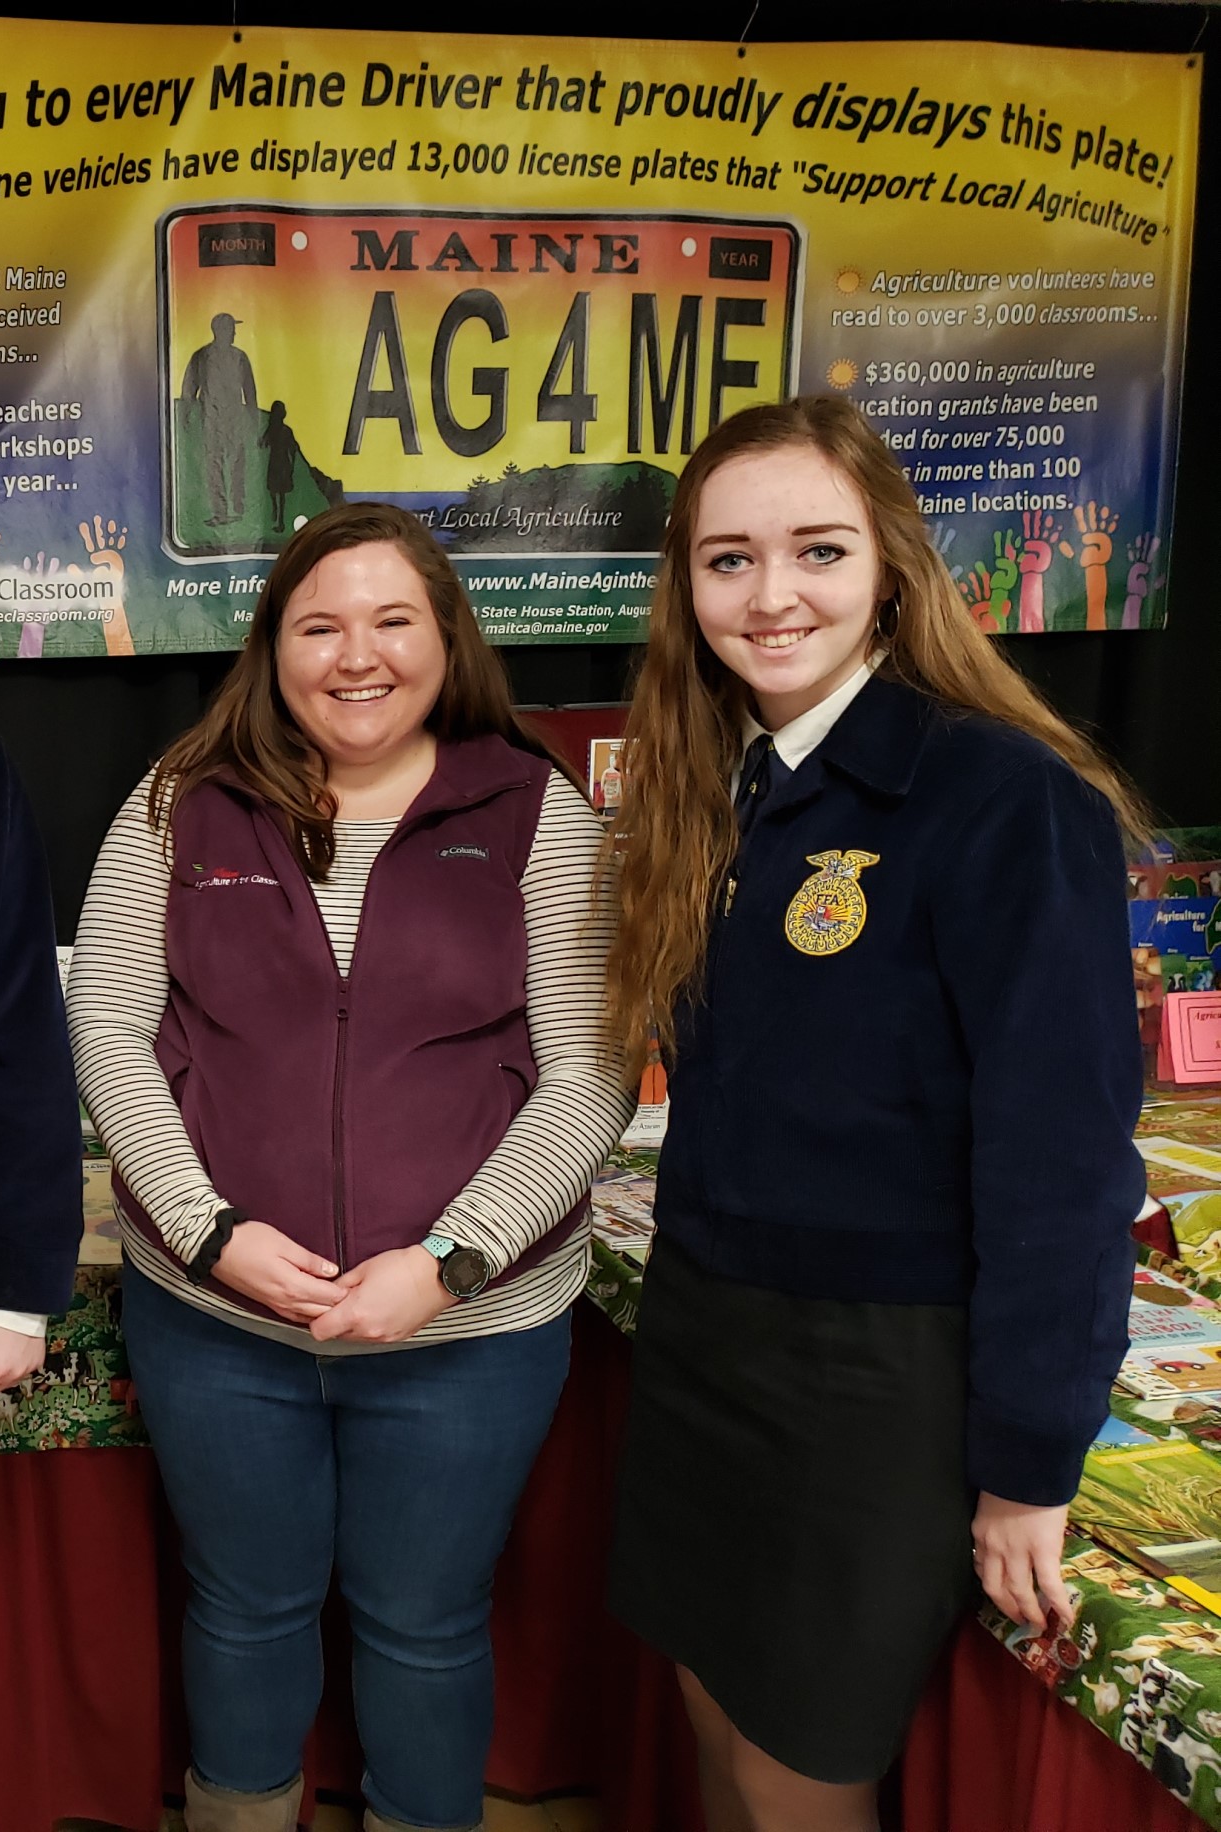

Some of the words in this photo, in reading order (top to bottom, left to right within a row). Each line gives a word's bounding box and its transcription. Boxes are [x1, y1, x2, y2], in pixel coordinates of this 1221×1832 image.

[26, 80, 71, 127] to
[86, 73, 193, 126] every
[210, 62, 346, 111] Maine
[361, 62, 502, 110] Driver
[515, 65, 603, 115] that
[614, 77, 782, 136] proudly
[792, 81, 992, 150] displays
[999, 102, 1063, 156] this
[1070, 125, 1174, 189] plate!
[43, 151, 151, 194] vehicles
[163, 141, 239, 180] have
[249, 138, 395, 179] displayed
[406, 141, 507, 180] 13,000
[518, 143, 622, 181] license
[630, 148, 720, 186] plates
[726, 149, 781, 191] that
[793, 160, 936, 204] "Support
[941, 172, 1023, 210] Local
[1029, 183, 1171, 247] Agriculture"
[211, 236, 267, 254] MONTH
[350, 228, 639, 275] MAINE
[719, 251, 759, 268] YEAR
[5, 265, 67, 291] Maine
[871, 269, 1001, 297] Agriculture
[1007, 267, 1105, 290] volunteers
[1109, 267, 1155, 289] have
[831, 305, 880, 328] read
[887, 306, 911, 326] to
[916, 307, 968, 327] over
[973, 304, 1037, 331] 3,000
[1039, 303, 1158, 325] classrooms...
[341, 287, 510, 457] AG
[536, 290, 598, 455] 4
[865, 359, 970, 388] $360,000
[975, 360, 993, 382] in
[997, 357, 1096, 386] agriculture
[938, 395, 997, 421] grants
[1001, 393, 1045, 415] have
[1048, 390, 1098, 413] been
[920, 427, 949, 450] for
[951, 431, 992, 449] over
[995, 424, 1065, 450] 75,000
[913, 460, 933, 482] in
[935, 463, 984, 481] more
[988, 456, 1035, 480] than
[1041, 456, 1081, 479] 100
[2, 472, 79, 497] year...
[972, 490, 1074, 513] locations.
[440, 503, 505, 528] Local
[502, 503, 623, 536] Agriculture
[166, 579, 222, 598] More
[481, 606, 517, 619] State
[520, 605, 564, 618] House
[567, 605, 615, 618] Station,
[618, 604, 653, 619] Augus
[485, 621, 609, 636] maitca@maine.gov
[448, 846, 487, 858] Columbia
[816, 894, 840, 906] FFA
[1157, 910, 1206, 925] Agriculture
[1192, 921, 1206, 932] for
